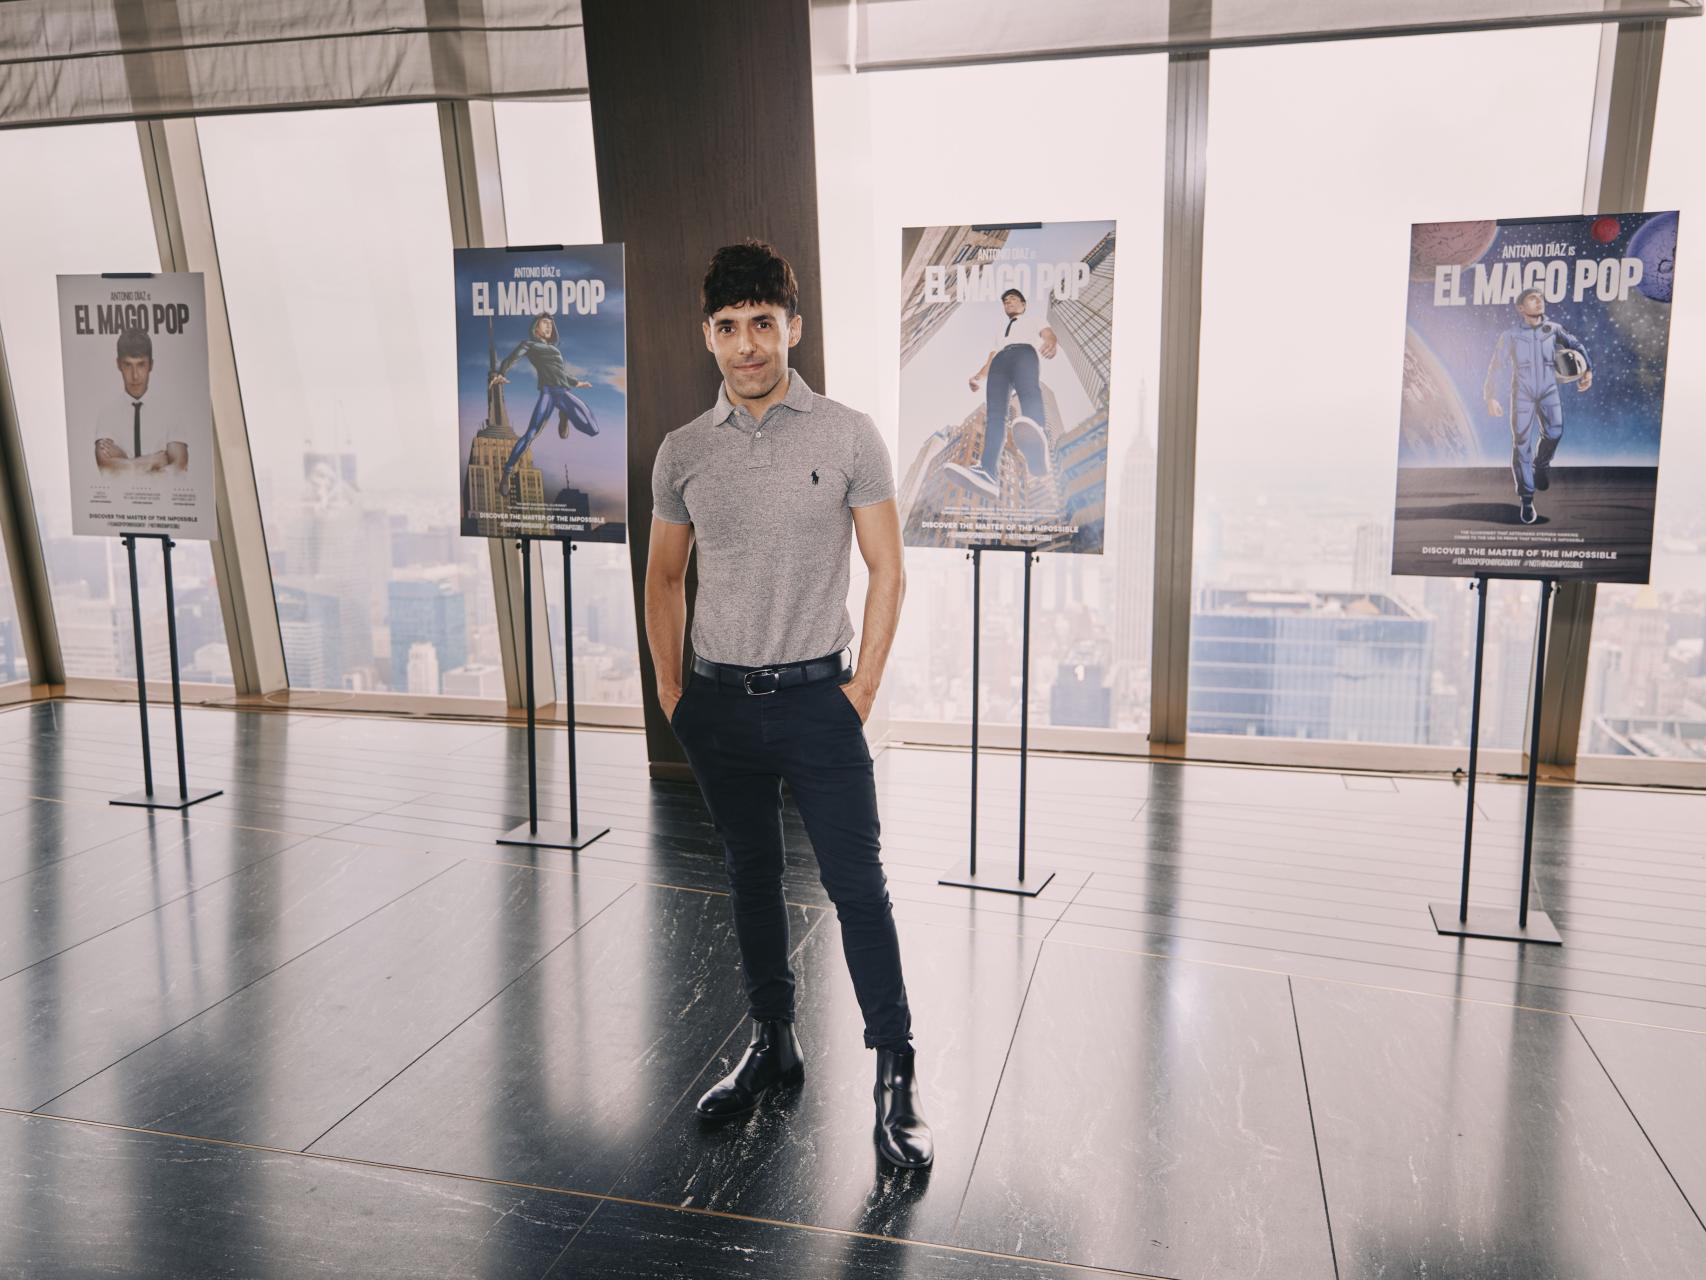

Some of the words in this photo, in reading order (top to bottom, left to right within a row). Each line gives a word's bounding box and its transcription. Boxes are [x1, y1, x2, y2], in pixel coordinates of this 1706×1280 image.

[1502, 245, 1543, 259] ANTONIO
[1545, 241, 1566, 257] DÍAZ
[514, 267, 540, 278] ANTONIO
[541, 265, 555, 278] DÍAZ
[925, 265, 951, 303] EL
[956, 263, 1031, 301] MAGO
[1036, 261, 1090, 301] POP
[1434, 265, 1466, 307] EL
[1473, 260, 1568, 306] MAGO
[1573, 258, 1644, 302] POP
[472, 282, 494, 316] EL
[498, 281, 558, 316] MAGO
[562, 279, 605, 315] POP
[75, 304, 94, 335] EL
[97, 303, 149, 335] MAGO
[152, 303, 190, 334] POP
[480, 512, 509, 520] DISCOVER
[546, 514, 556, 522] OF
[569, 516, 605, 524] IMPOSSIBLE
[921, 521, 959, 529] DISCOVER
[959, 522, 972, 530] THE
[1018, 524, 1034, 532] THE
[1034, 525, 1079, 534] IMPOSSIBLE
[1422, 546, 1466, 556] DISCOVER
[1468, 547, 1486, 556] THE
[1487, 548, 1524, 557] MASTER
[1526, 549, 1539, 557] OF
[1541, 550, 1560, 558] THE
[1561, 550, 1617, 560] IMPOSSIBLE
